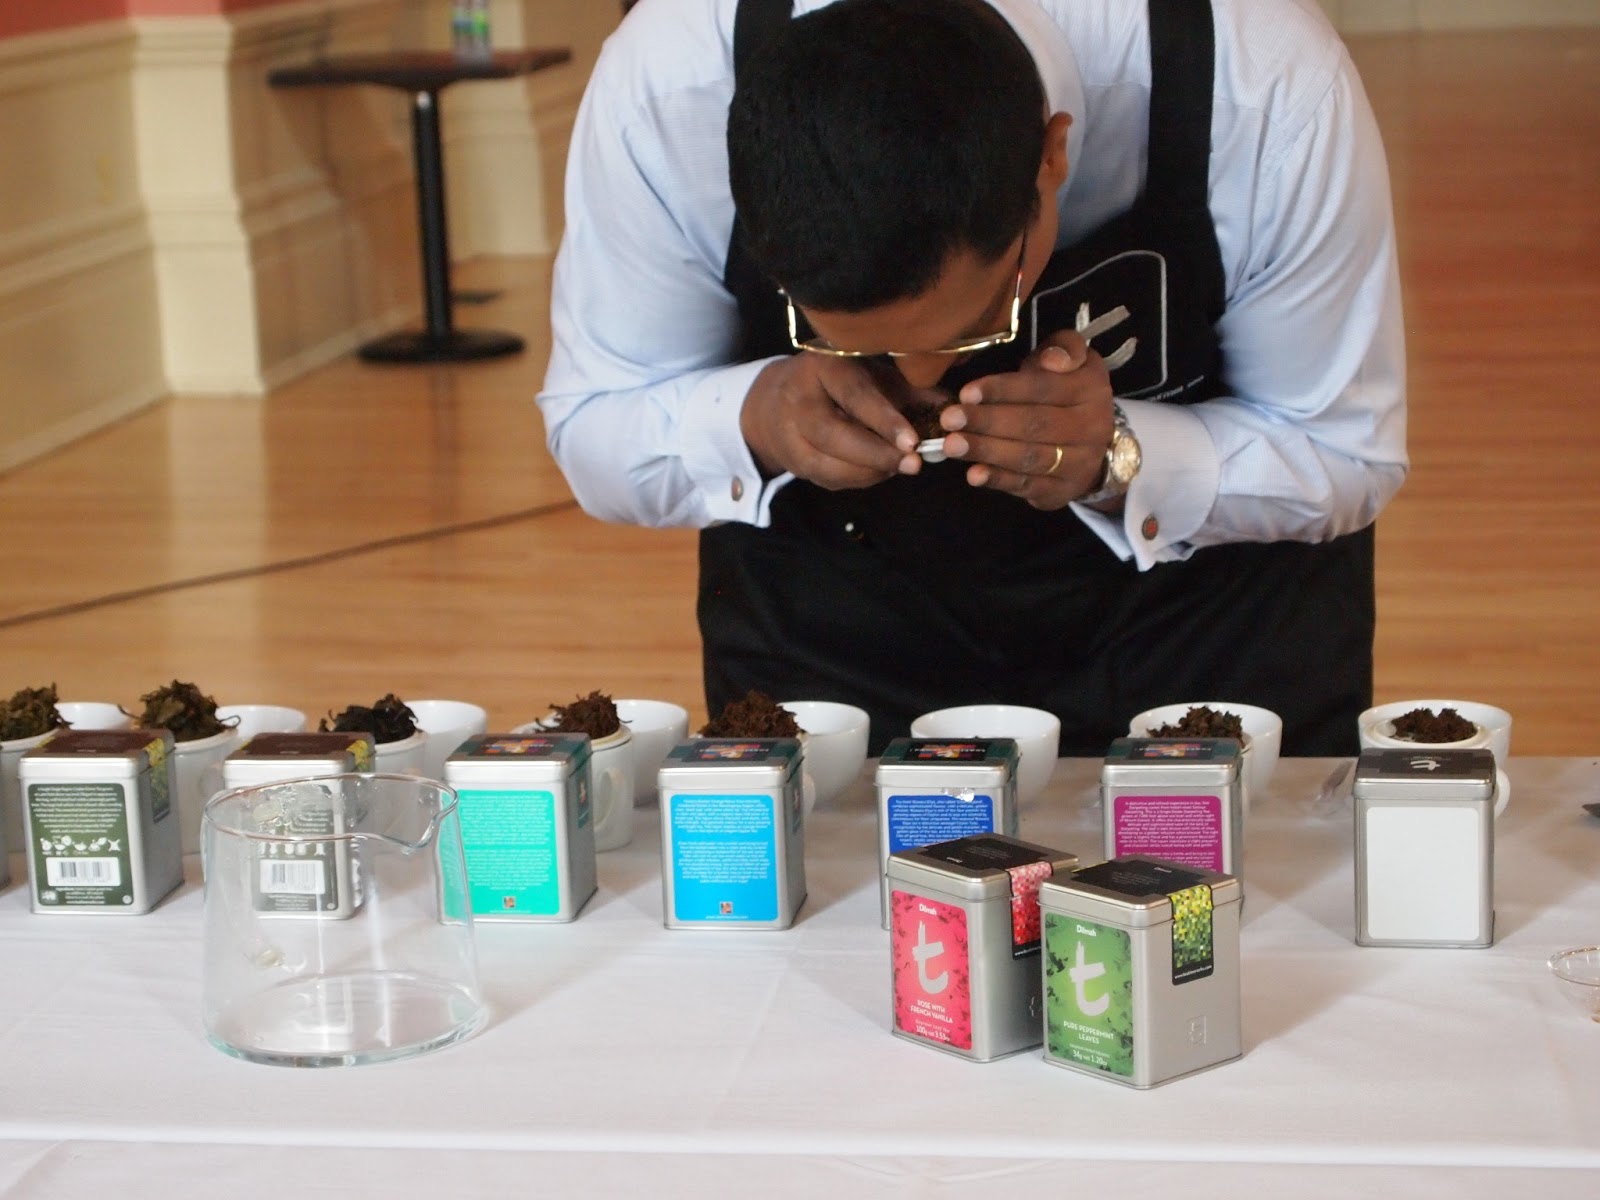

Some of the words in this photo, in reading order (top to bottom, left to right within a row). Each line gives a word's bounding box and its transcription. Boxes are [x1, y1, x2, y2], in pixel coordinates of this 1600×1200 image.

[919, 903, 937, 916] Dilmah
[1076, 924, 1097, 937] Dilmah
[912, 920, 949, 994] t
[1069, 940, 1110, 1016] t
[910, 1004, 932, 1018] FRENCH
[931, 1011, 953, 1024] VANILLA
[931, 1003, 946, 1014] WITH
[1063, 1020, 1079, 1031] PURE
[1078, 1024, 1114, 1040] PEPPERMINT
[1078, 1032, 1100, 1045] LEAVES
